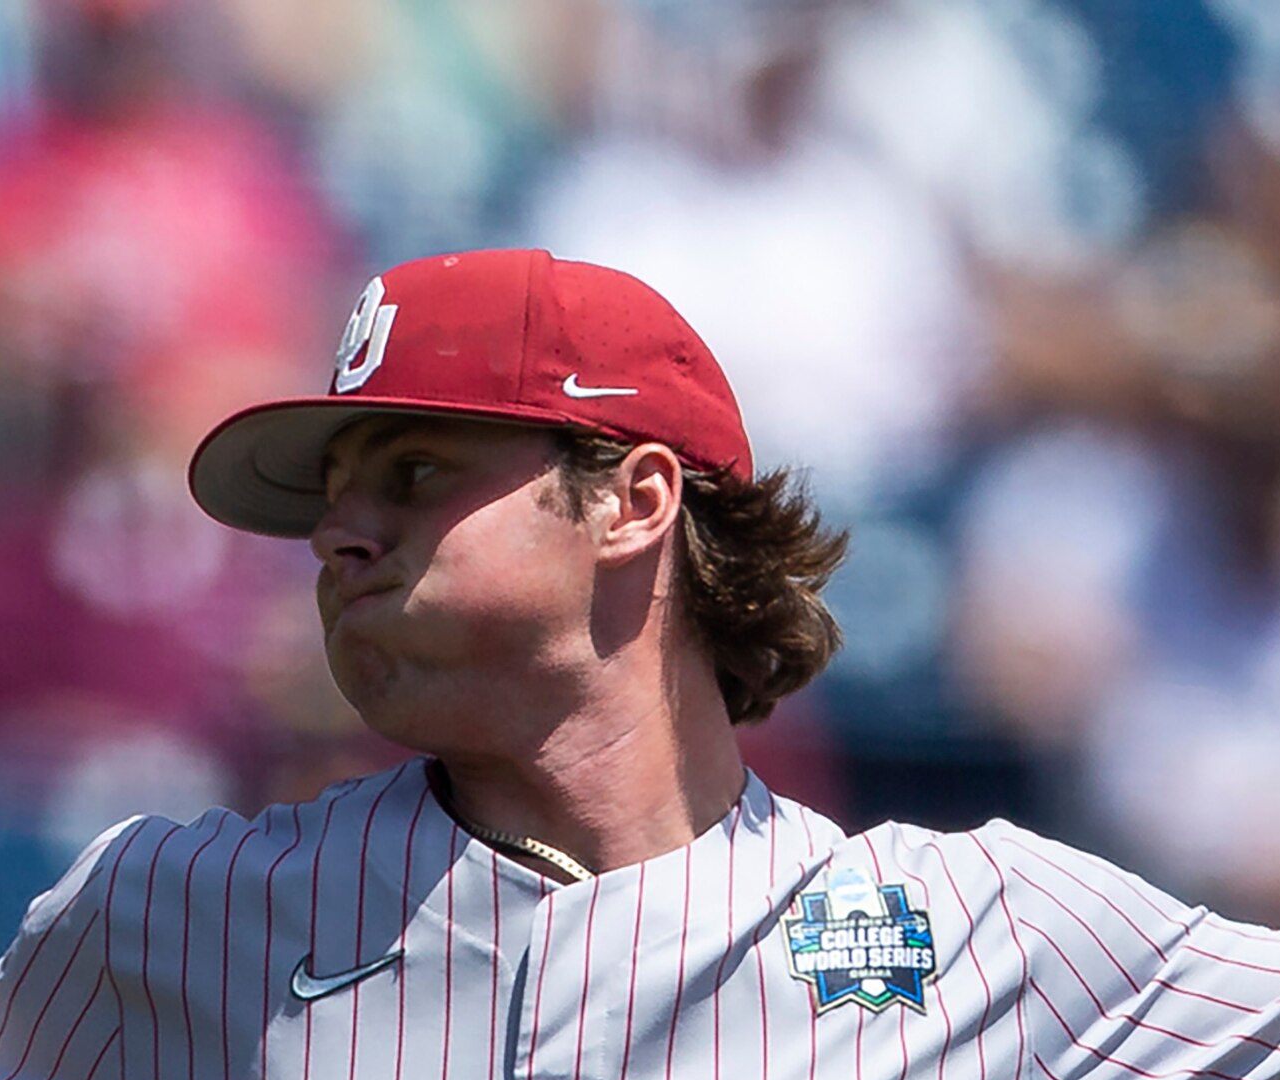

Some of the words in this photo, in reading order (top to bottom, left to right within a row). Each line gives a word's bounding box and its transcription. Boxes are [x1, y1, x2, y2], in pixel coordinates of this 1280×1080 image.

[820, 926, 905, 951] COLLEGE
[795, 949, 867, 973] WORLD
[868, 946, 933, 969] SERIES
